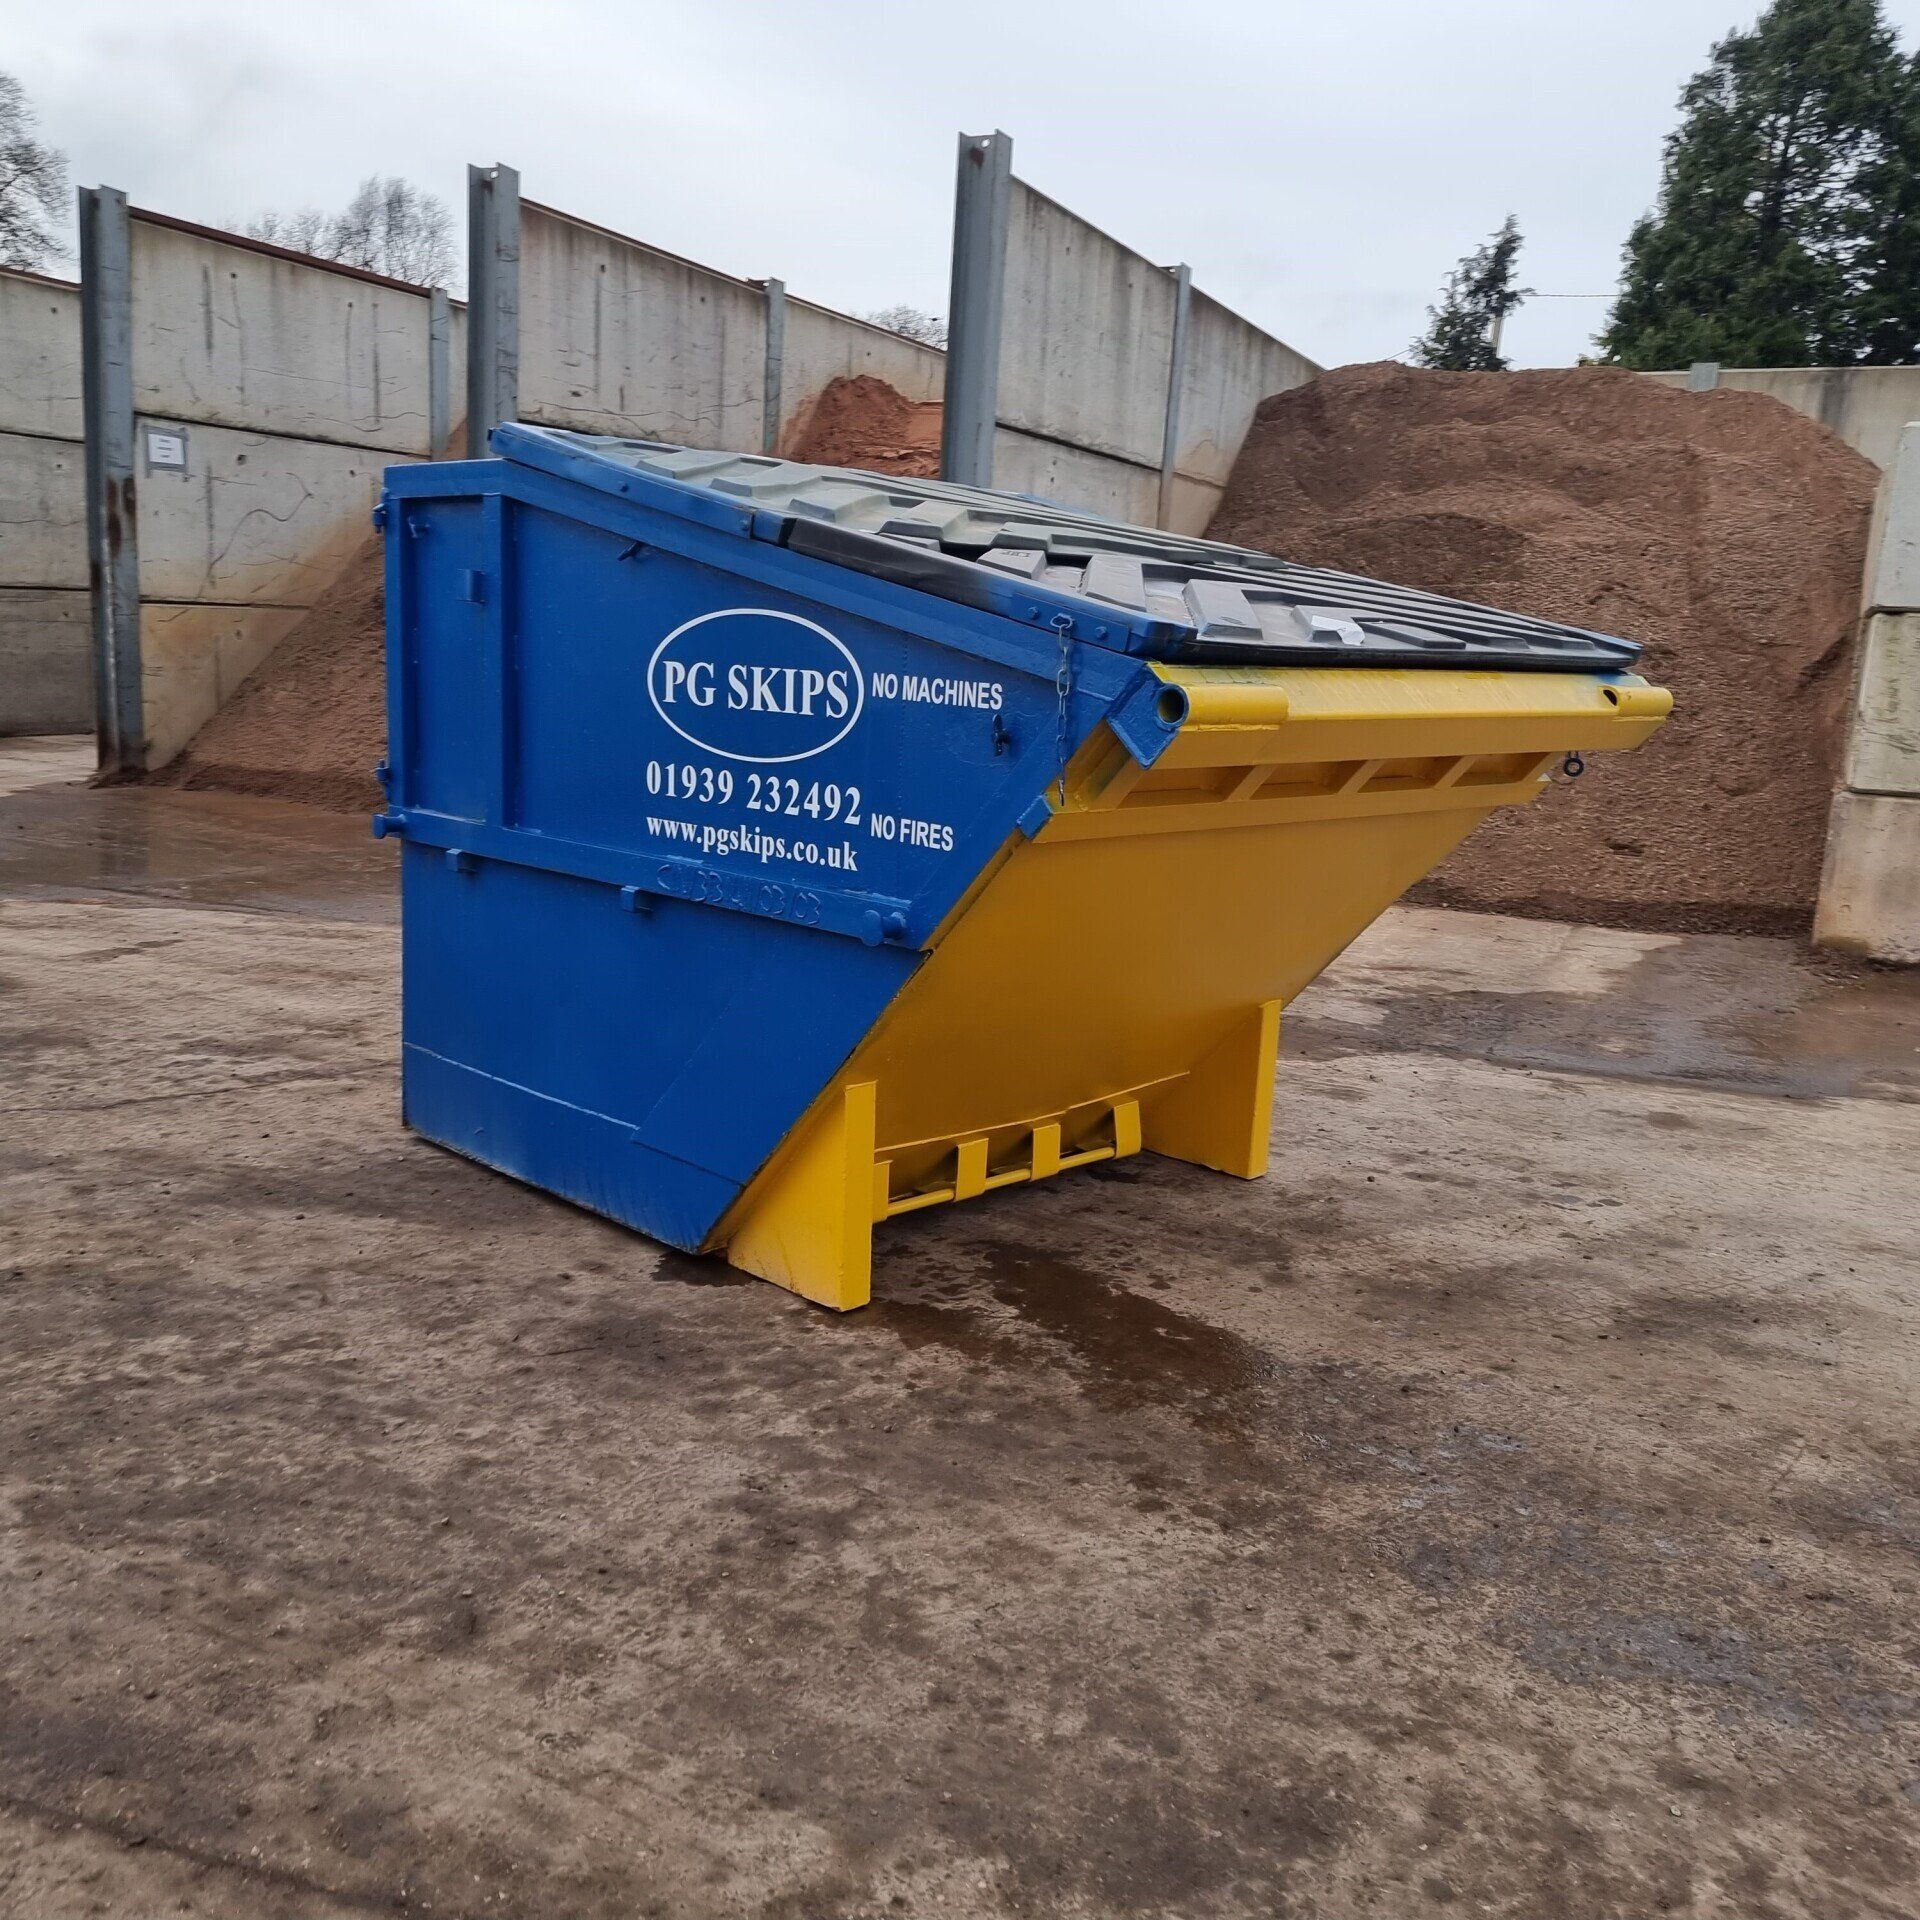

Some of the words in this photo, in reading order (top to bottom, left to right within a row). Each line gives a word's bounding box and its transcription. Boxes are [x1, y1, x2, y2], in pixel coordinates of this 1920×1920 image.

[662, 660, 717, 707] PG
[727, 664, 849, 719] SKIPS
[872, 672, 898, 700] NO
[902, 675, 1003, 711] MACHINES
[645, 760, 734, 805] 01939
[746, 773, 861, 826] 232492
[645, 815, 858, 872] www.pgskips.co.uk
[870, 812, 896, 841] NO
[900, 818, 954, 852] FIRES
